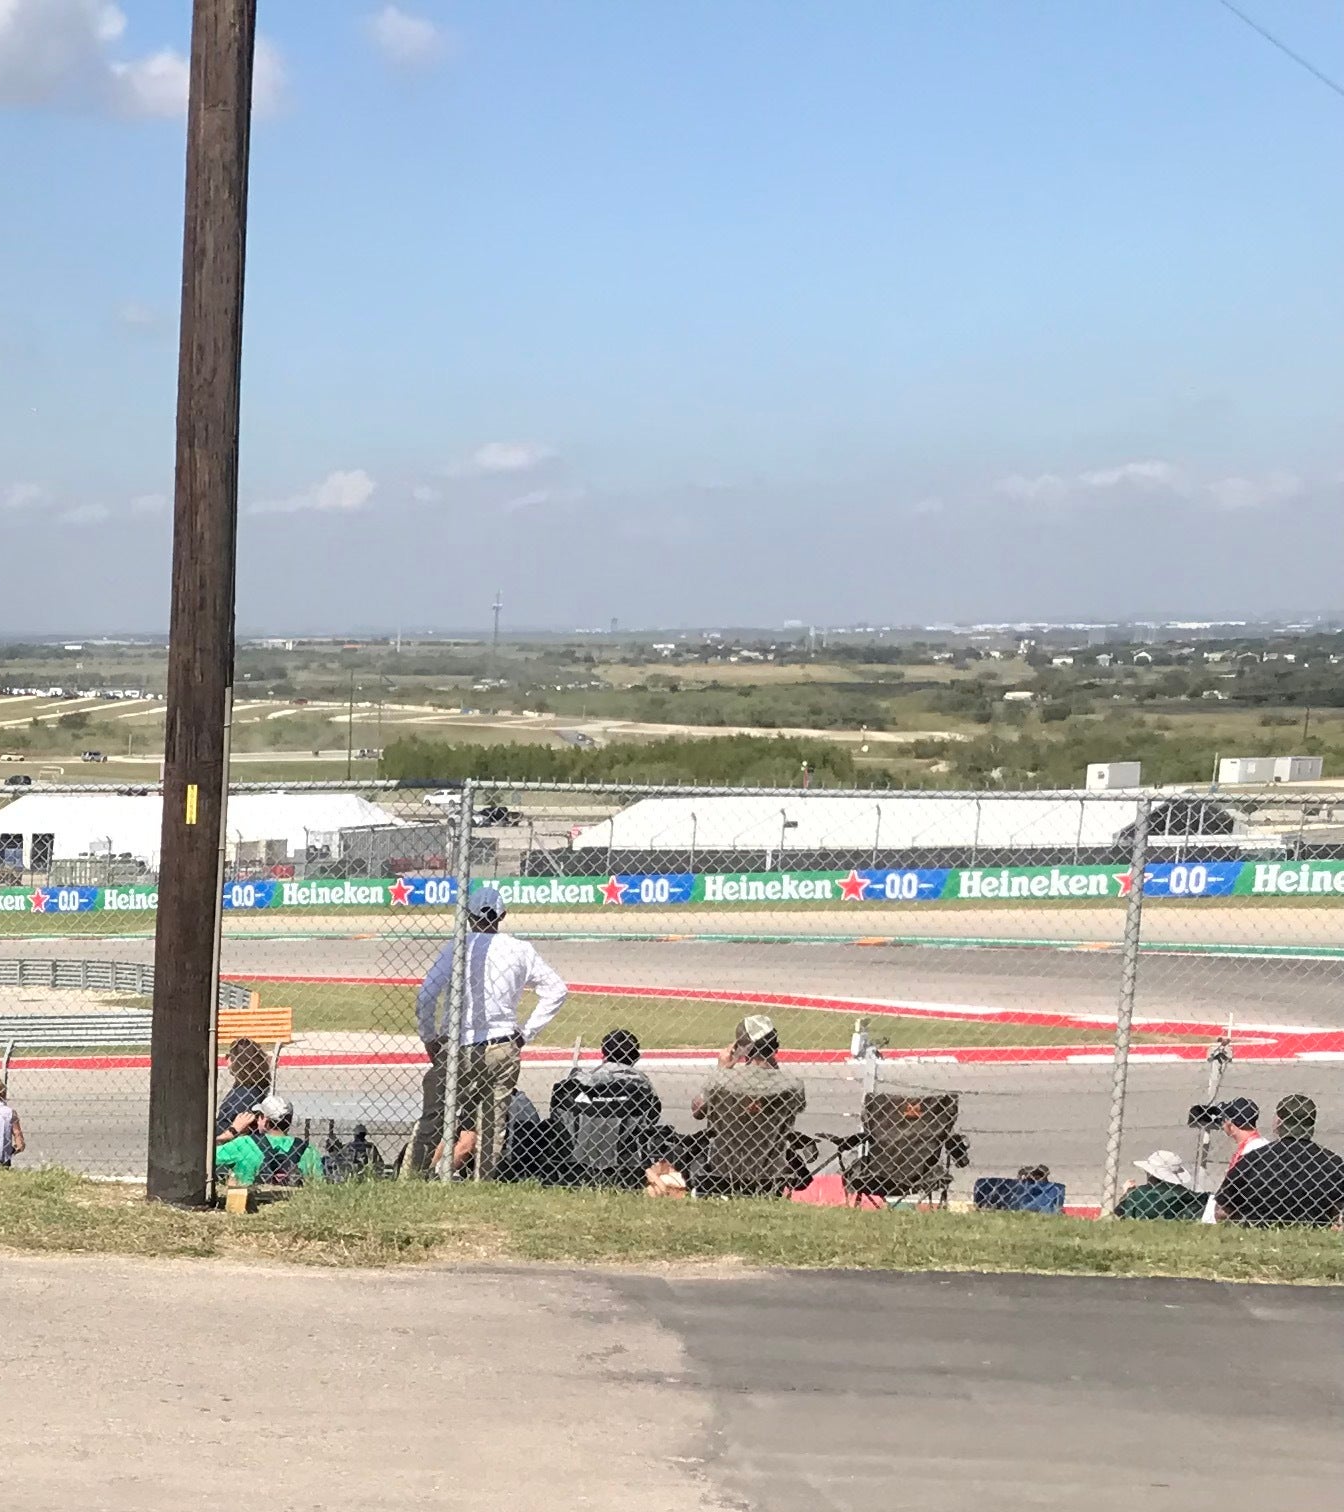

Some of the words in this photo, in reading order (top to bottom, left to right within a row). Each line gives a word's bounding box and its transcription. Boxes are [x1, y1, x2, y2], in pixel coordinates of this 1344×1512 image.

[703, 874, 833, 901] Heineken
[958, 869, 1109, 898] Heineken
[1252, 863, 1344, 893] Heine
[103, 889, 159, 911] Heine
[282, 882, 384, 905] Heineken
